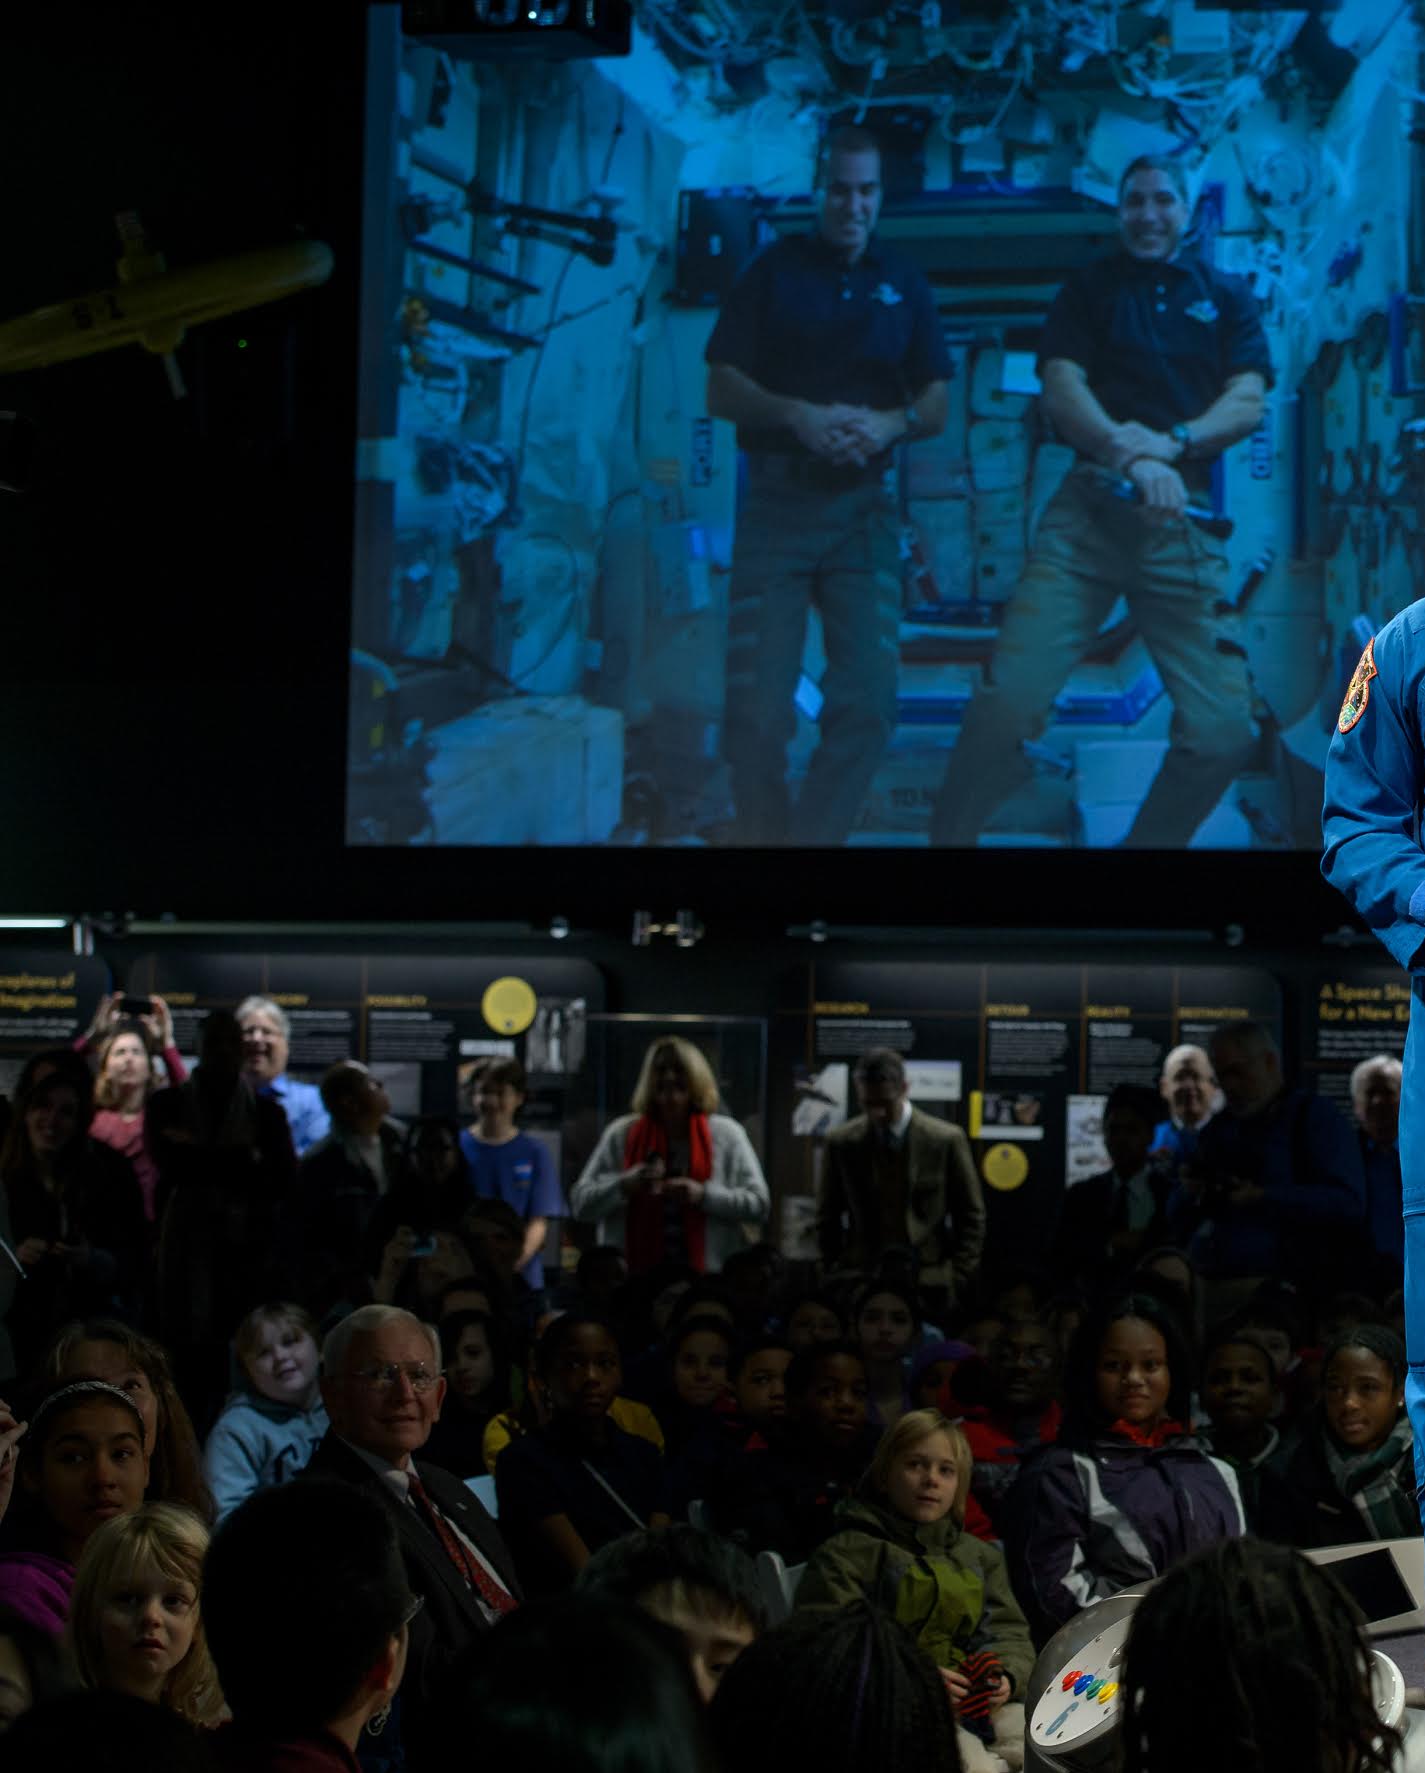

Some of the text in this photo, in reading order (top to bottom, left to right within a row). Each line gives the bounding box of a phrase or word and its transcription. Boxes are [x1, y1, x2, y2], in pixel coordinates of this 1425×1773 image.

[1319, 983, 1334, 999] A
[1335, 982, 1382, 1003] Space
[1319, 1002, 1343, 1021] for
[1345, 1007, 1357, 1021] a
[1358, 1004, 1394, 1021] New
